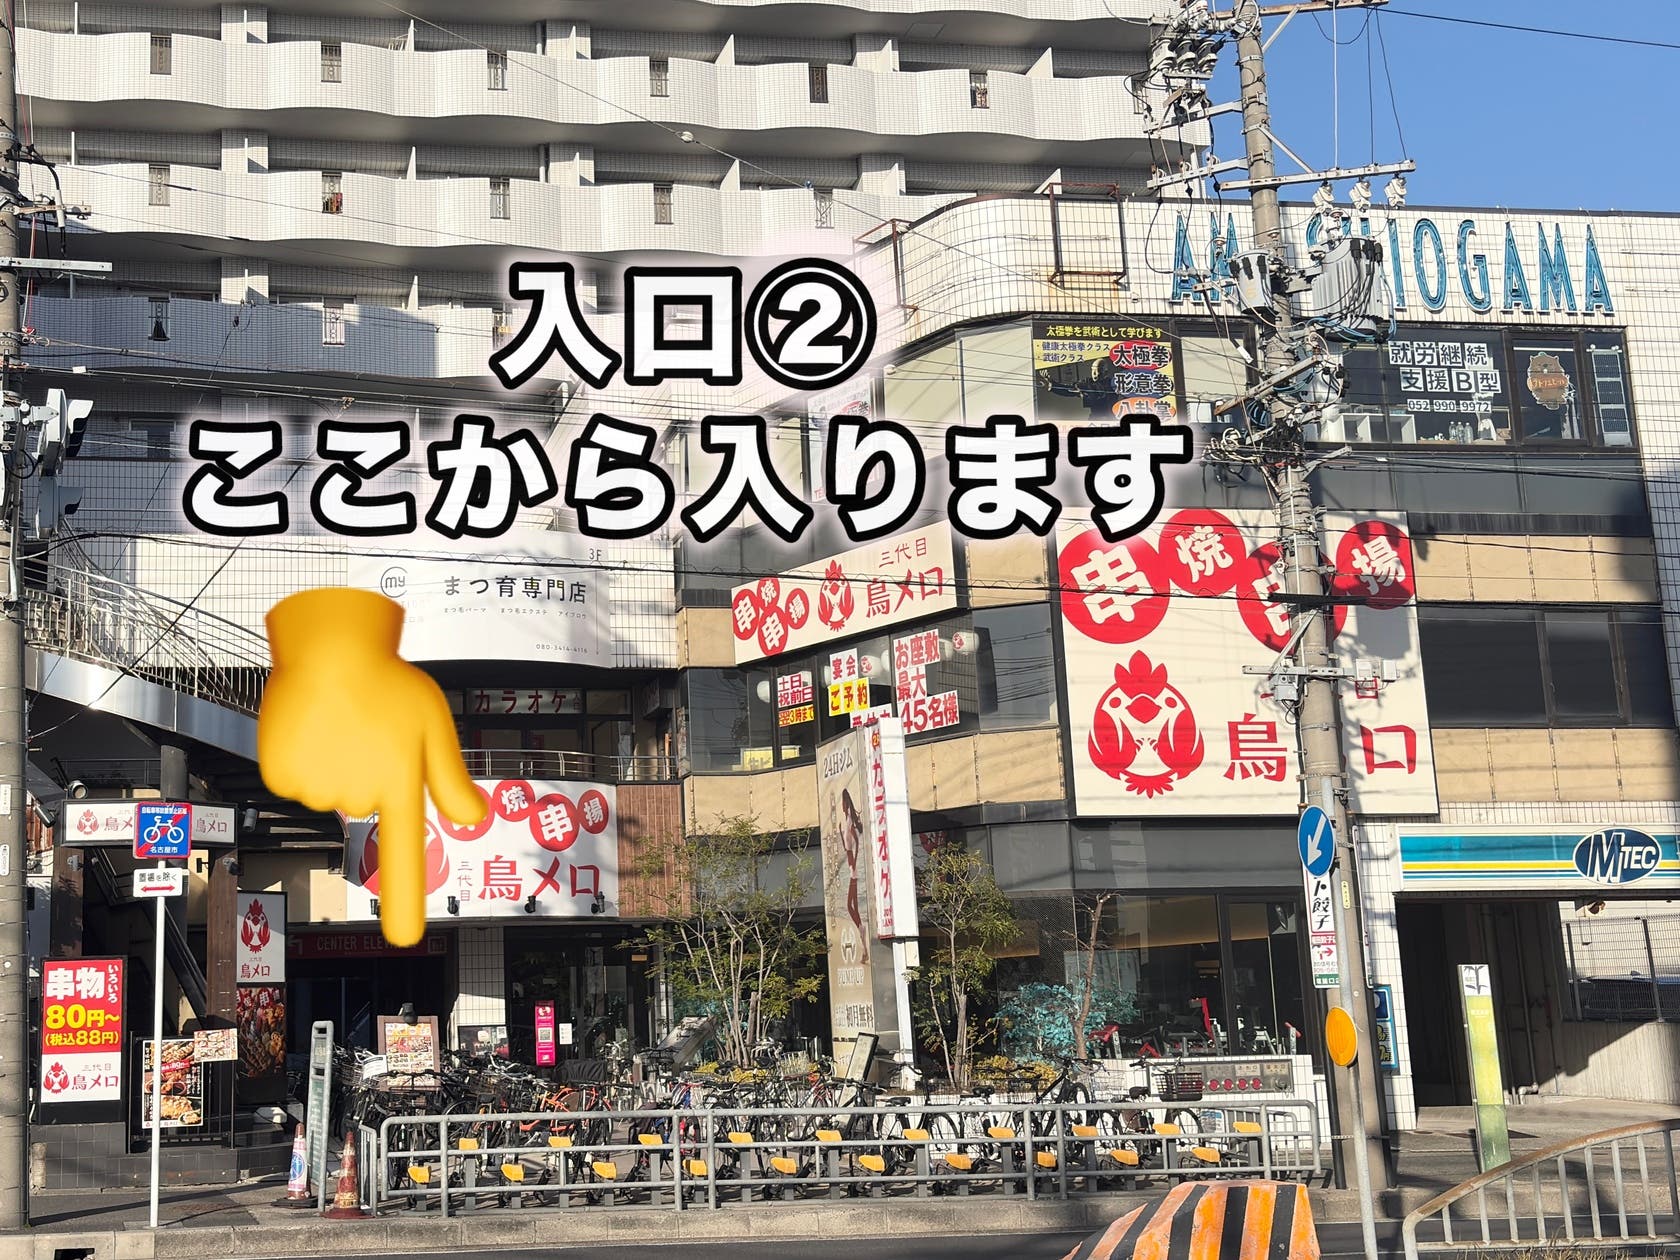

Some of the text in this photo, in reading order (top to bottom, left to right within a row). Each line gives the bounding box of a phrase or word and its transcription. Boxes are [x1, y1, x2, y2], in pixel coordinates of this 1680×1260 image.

[1306, 213, 1615, 314] IOGAMA
[1046, 324, 1163, 339] 太極拳を武術として学びます
[1114, 344, 1170, 367] 太極拳
[1389, 341, 1488, 366] 就労継続
[1115, 372, 1173, 395] 形意拳
[1402, 368, 1500, 393] 支援B型
[1408, 399, 1490, 412] 052 990 9972
[588, 548, 602, 560] 3F
[878, 536, 927, 569] 三代目
[444, 576, 587, 605] まつ育専門店
[895, 631, 940, 670] お座敷
[832, 655, 856, 680] 宴会
[779, 674, 802, 692] 土日
[897, 667, 926, 702] 最大
[475, 689, 567, 714] カラオケ
[779, 687, 813, 706] 祝前日
[830, 682, 868, 712] ご予約
[779, 707, 814, 727] 翌3時まで
[901, 692, 959, 734] 45名様
[1223, 713, 1417, 782] 鳥ロ
[104, 816, 134, 832] 鳥メ
[150, 846, 178, 854] 名古屋市
[1586, 832, 1657, 883] MTEC
[457, 860, 473, 901] 三代目
[477, 854, 601, 902] 鳥メロ
[46, 967, 105, 1000] 串物
[107, 964, 119, 1004] いろいろ
[45, 1004, 120, 1030] 80円〜
[45, 1030, 119, 1046] (税込88円)
[71, 1074, 119, 1091] 鳥メロ
